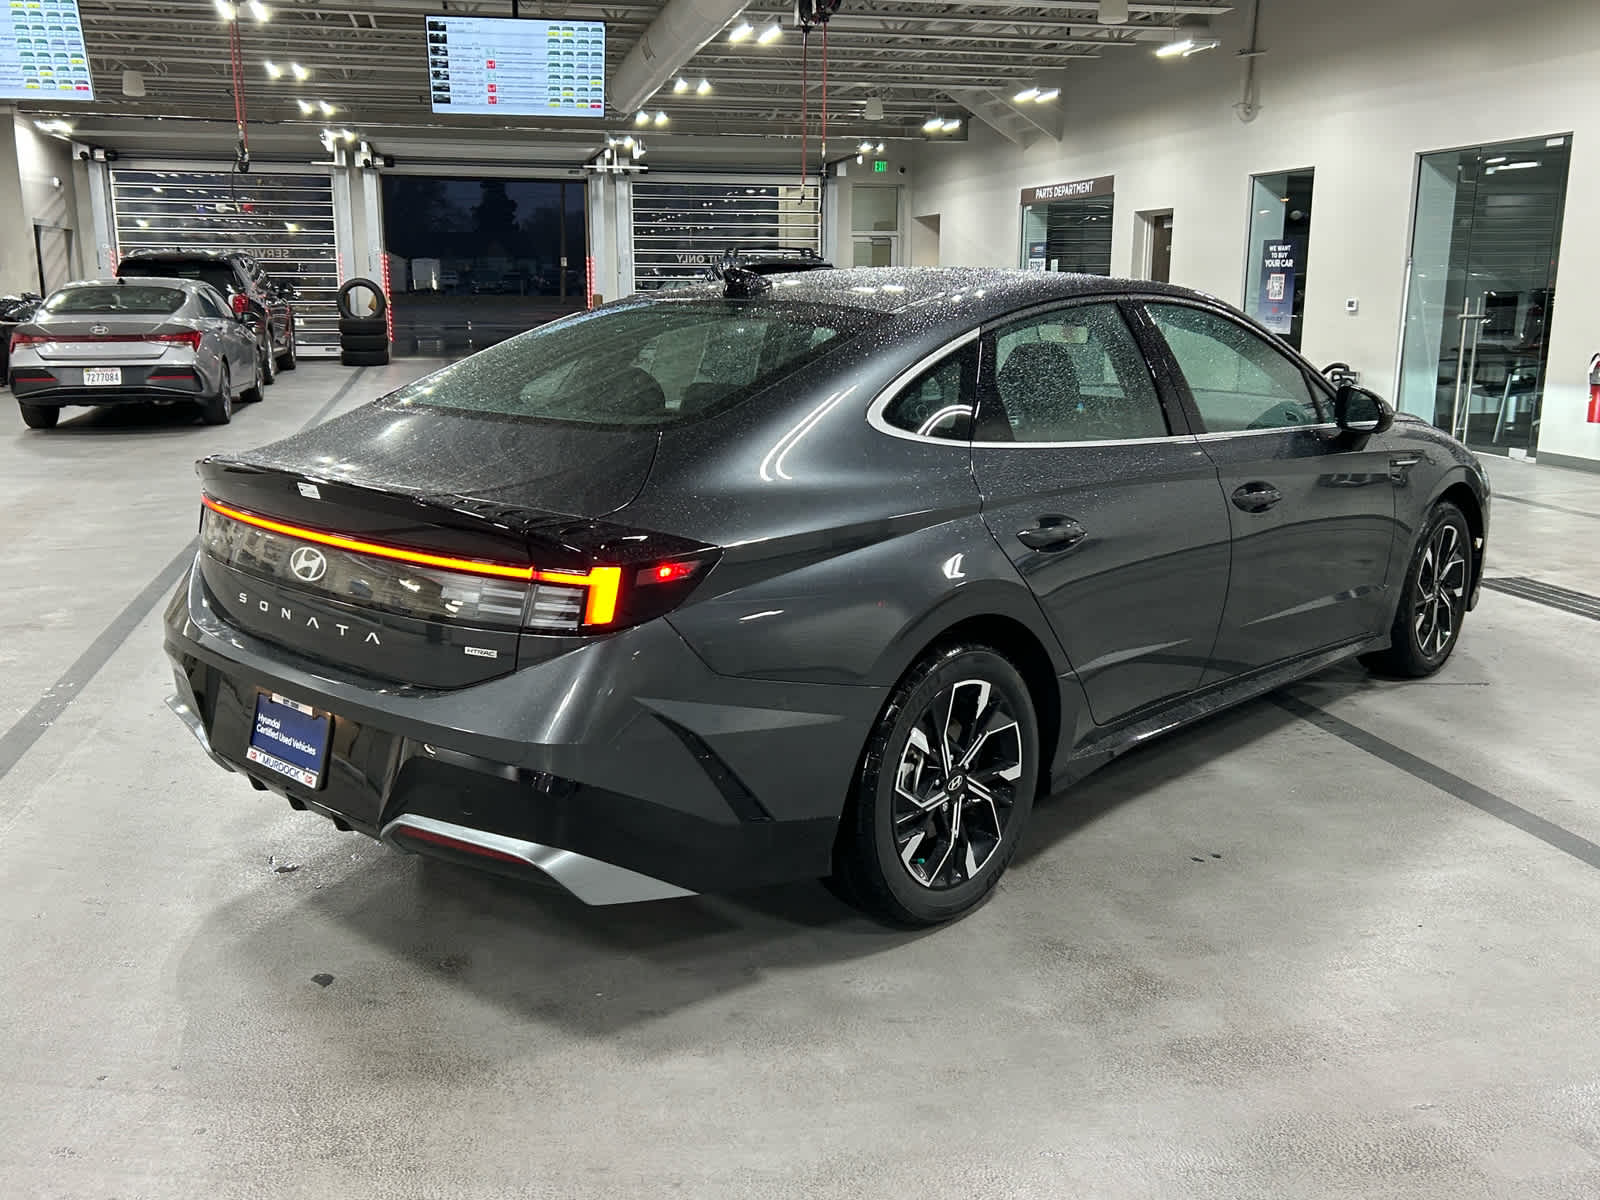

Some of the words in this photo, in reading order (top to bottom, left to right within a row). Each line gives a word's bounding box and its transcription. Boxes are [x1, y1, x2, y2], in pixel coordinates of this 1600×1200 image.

[874, 160, 887, 172] EXIT
[1035, 187, 1053, 199] PARTS
[1054, 181, 1094, 197] DEPARTMENT
[1265, 259, 1280, 267] YOUR
[1281, 259, 1293, 267] CAR
[86, 373, 119, 383] 7277084
[239, 592, 381, 645] SONATA
[466, 648, 496, 657] HTRAC
[258, 712, 280, 730] Hyundai
[256, 723, 279, 740] Certified
[279, 732, 293, 746] Used
[292, 740, 317, 756] Vehicles
[262, 755, 300, 778] MURDOCK
